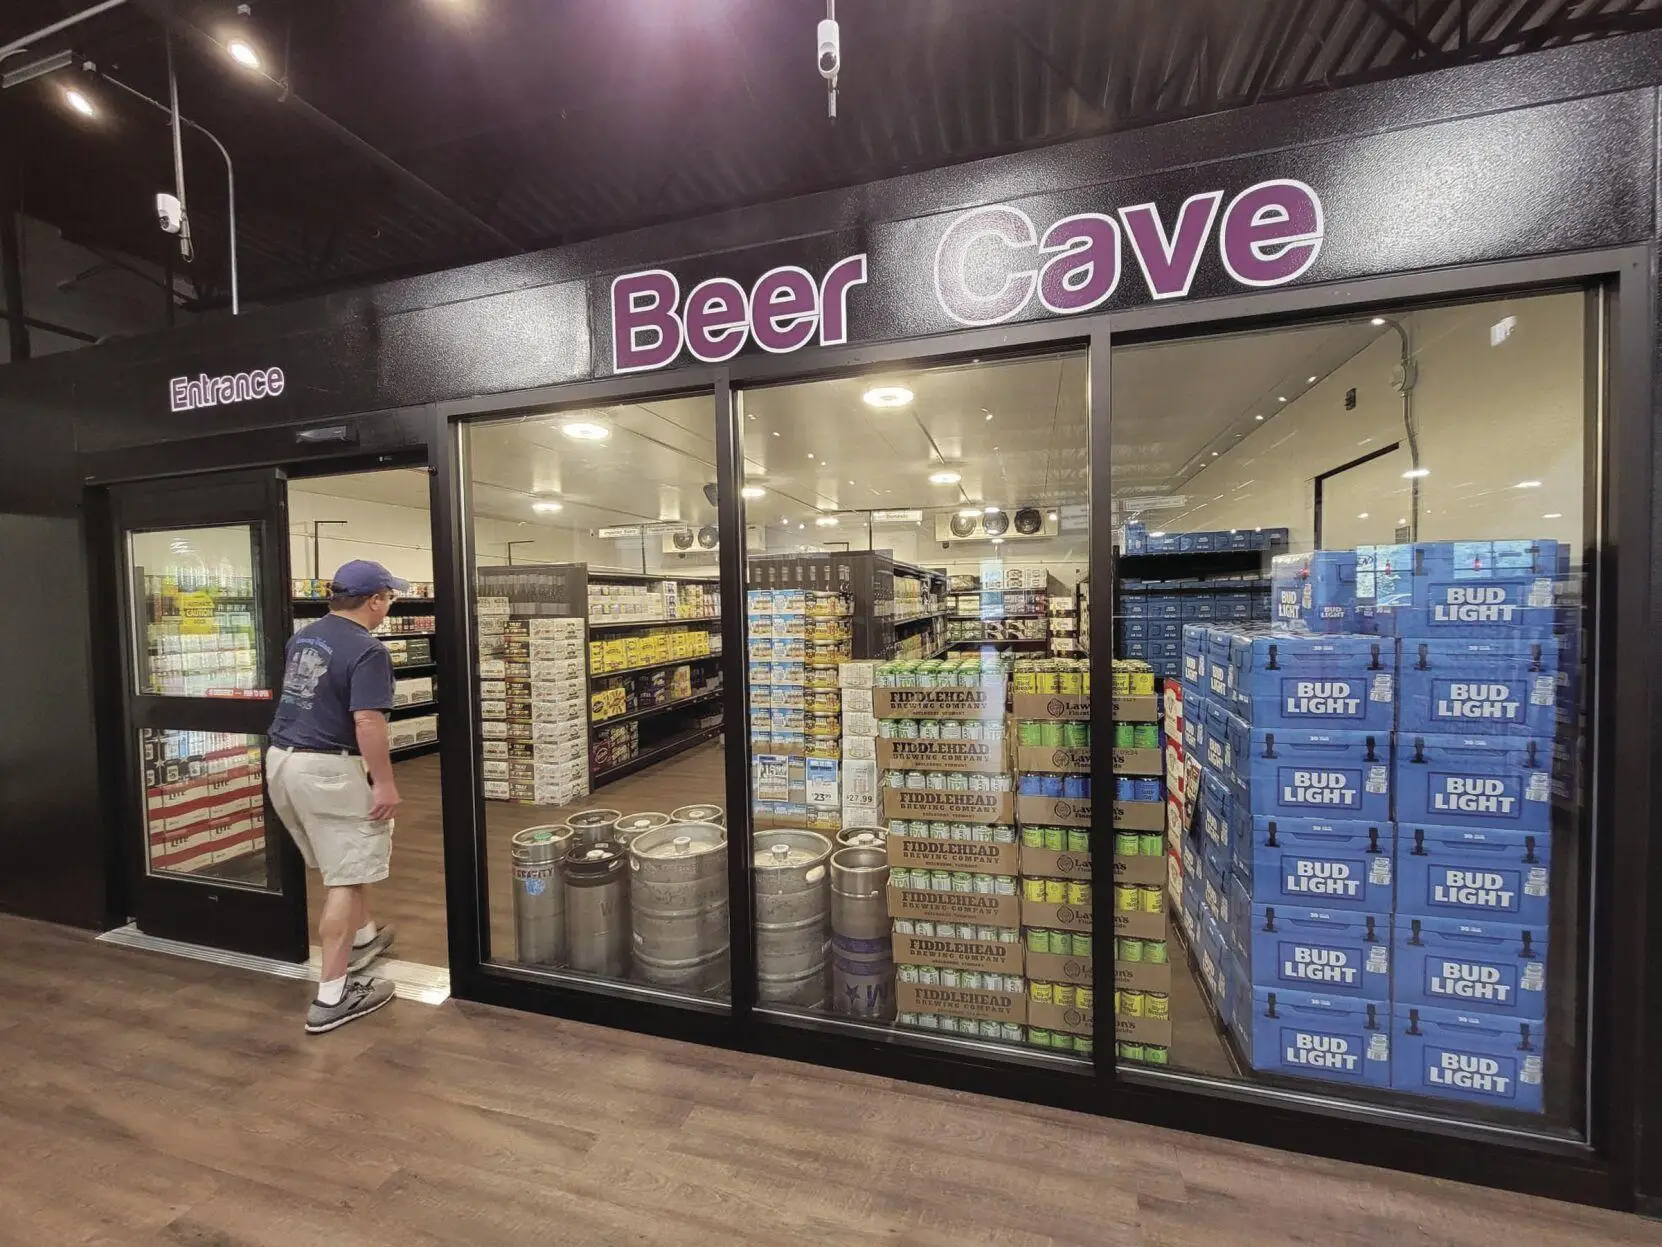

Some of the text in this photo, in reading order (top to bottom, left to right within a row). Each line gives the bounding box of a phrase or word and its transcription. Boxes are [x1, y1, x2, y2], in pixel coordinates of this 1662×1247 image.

[610, 178, 1325, 374] Beer Cave
[170, 366, 285, 412] Entrance
[1281, 590, 1297, 604] BUD
[1447, 587, 1506, 604] BUD
[1278, 603, 1300, 619] LIGHT
[1434, 604, 1516, 621] LIGHT
[889, 691, 987, 702] FIDDLEHEAD
[1297, 682, 1350, 697] BUD
[1450, 683, 1509, 700] BUD
[1287, 697, 1360, 714] LIGHT
[1438, 700, 1520, 718] LIGHT
[892, 742, 989, 755] FIDDLEHEAD
[1294, 771, 1347, 788] BUD
[1446, 777, 1504, 796] BUD
[900, 792, 997, 806] FIDDLEHEAD
[1284, 786, 1356, 805] LIGHT
[1434, 793, 1515, 813] LIGHT
[900, 803, 997, 813] BREWING COMPANY
[903, 840, 1000, 857] FIDDLEHEAD
[903, 852, 948, 861] BREWING
[952, 853, 1000, 864] COMPANY
[1297, 860, 1349, 879] BUD
[1287, 875, 1360, 895] LIGHT
[1446, 870, 1504, 890] BUD
[902, 891, 999, 908] FIDDLEHEAD
[1434, 885, 1514, 907] LIGHT
[910, 939, 1007, 957] FIDDLEHEAD
[1294, 947, 1347, 966] BUD
[959, 953, 1006, 963] COMPANY
[1284, 961, 1357, 983] LIGHT
[1443, 962, 1500, 983] BUD
[914, 988, 1012, 1007] FIDDLEHEAD
[1431, 977, 1510, 1001] LIGHT
[1296, 1033, 1348, 1053] BUD
[1287, 1047, 1358, 1070] LIGHT
[1441, 1052, 1499, 1075] BUD
[1430, 1066, 1510, 1093] LIGHT
